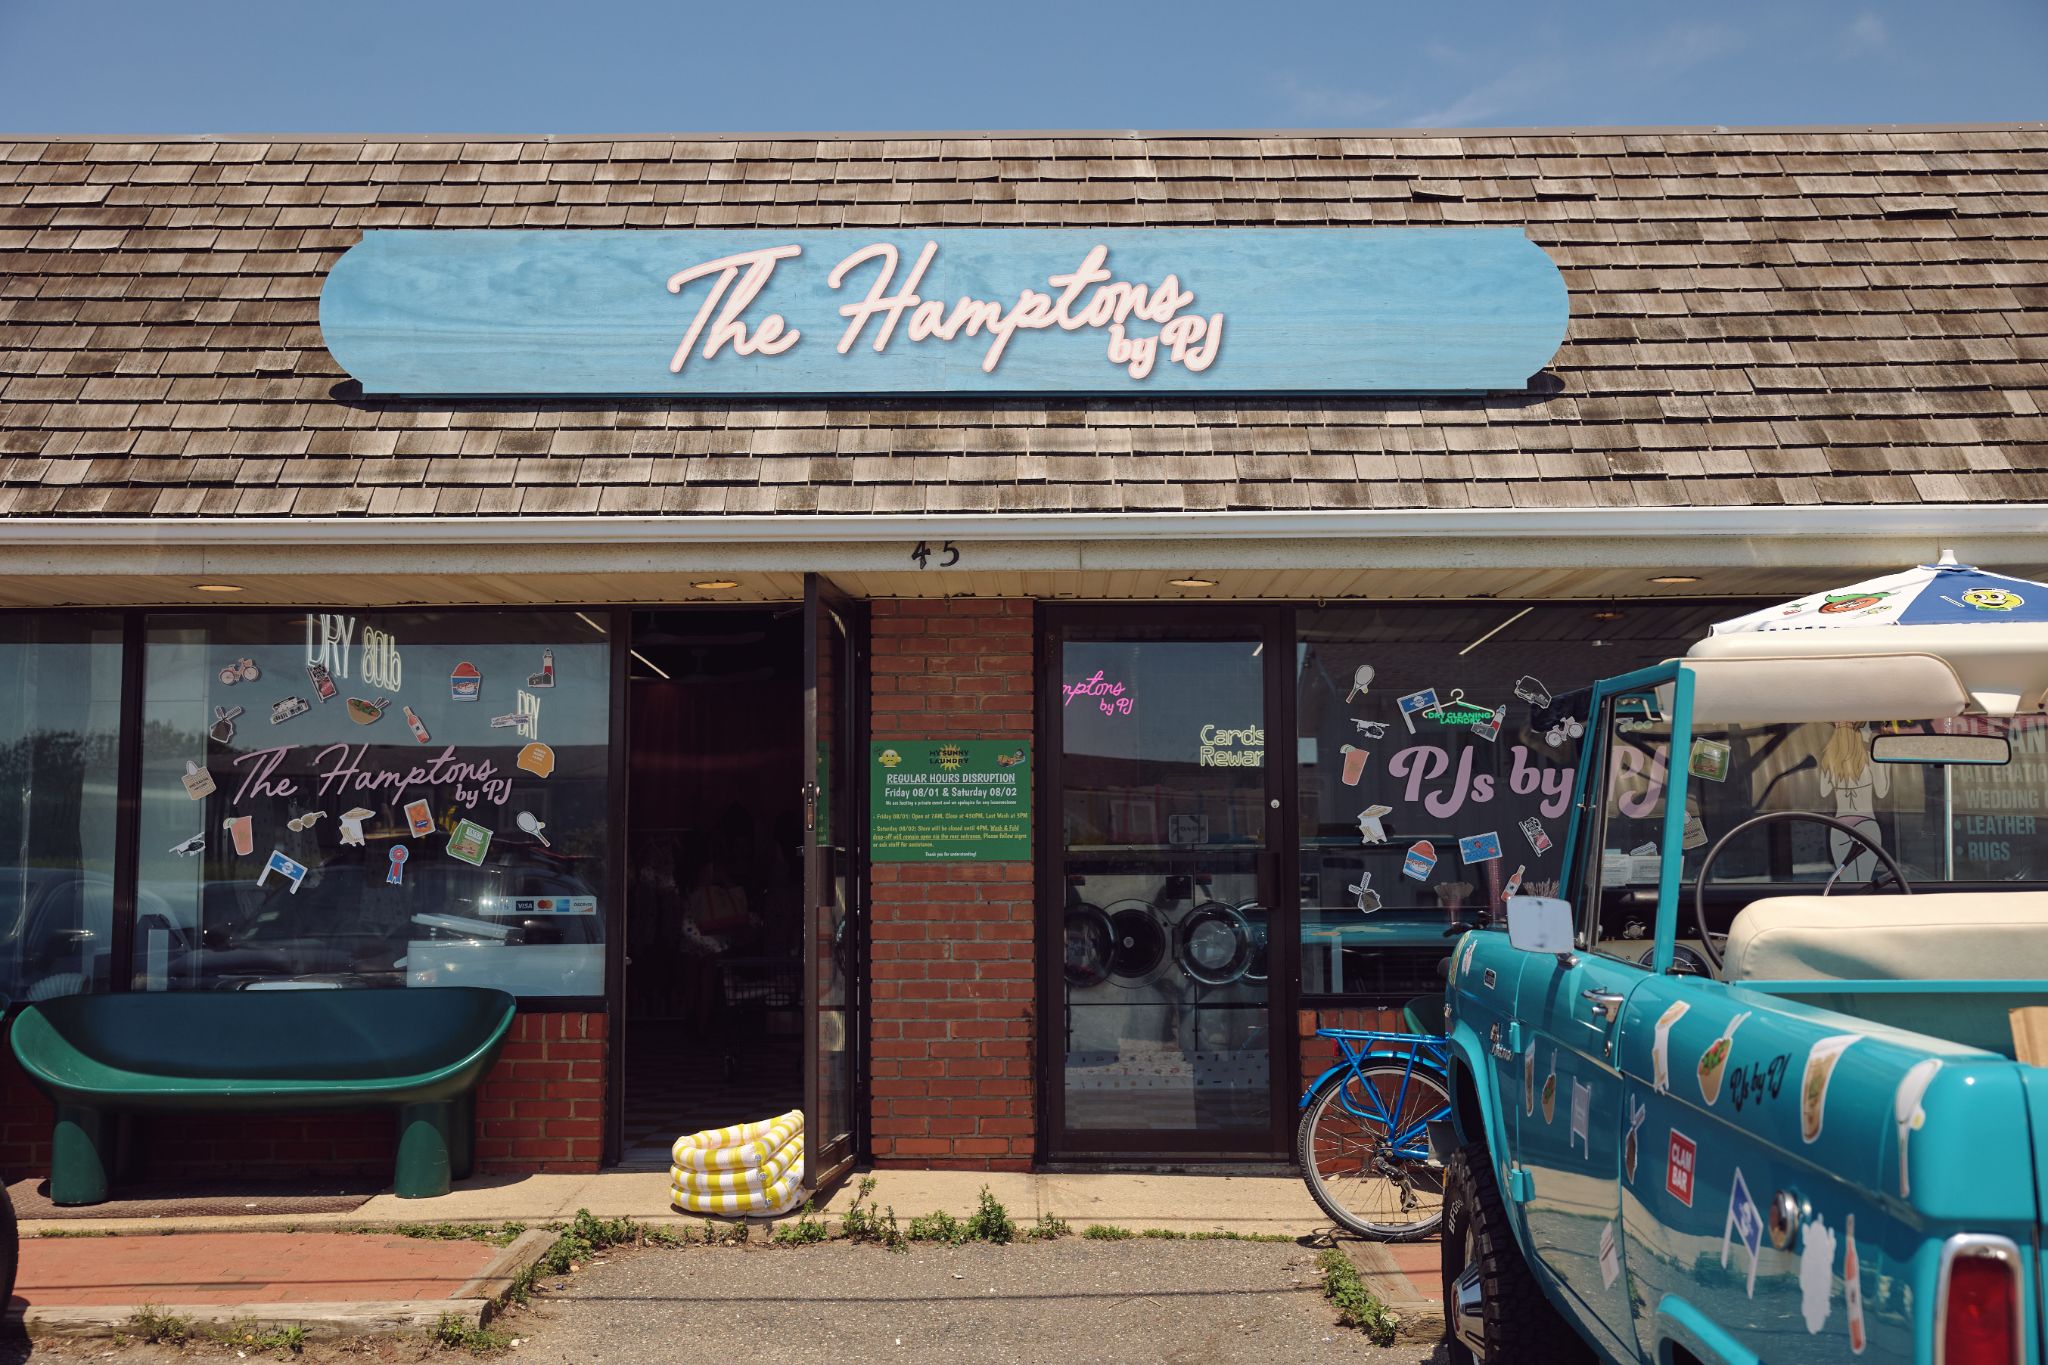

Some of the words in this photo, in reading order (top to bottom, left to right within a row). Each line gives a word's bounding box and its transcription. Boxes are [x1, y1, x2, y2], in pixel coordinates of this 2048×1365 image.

[666, 244, 801, 373] The
[827, 241, 1193, 373] Hamptons
[1107, 323, 1160, 380] by
[1159, 313, 1223, 372] PJ
[911, 540, 960, 570] 45
[306, 613, 355, 678] DRY
[1099, 698, 1115, 716] by
[1116, 697, 1134, 715] PJ
[1200, 724, 1264, 746] Cards
[233, 744, 300, 806] The
[315, 743, 498, 806] Hamptons
[886, 773, 927, 784] REGULAR
[929, 773, 960, 783] HOURS
[962, 773, 1016, 783] DISRUPTION
[1388, 746, 1495, 819] PJs
[1510, 746, 1575, 819] by
[1606, 746, 1668, 819] PJ
[455, 783, 479, 809] by
[482, 778, 512, 805] PJ
[885, 788, 911, 799] Friday
[912, 788, 939, 798] 08/01
[942, 787, 949, 797] &
[951, 787, 987, 799] Saturday
[989, 787, 1017, 797] 08/02
[1966, 789, 2039, 809] WEDDING
[1966, 816, 2036, 835] LEATHER
[1968, 842, 2011, 861] RUGS
[1671, 1142, 1693, 1172] CLAM
[1671, 1166, 1688, 1193] BAR
